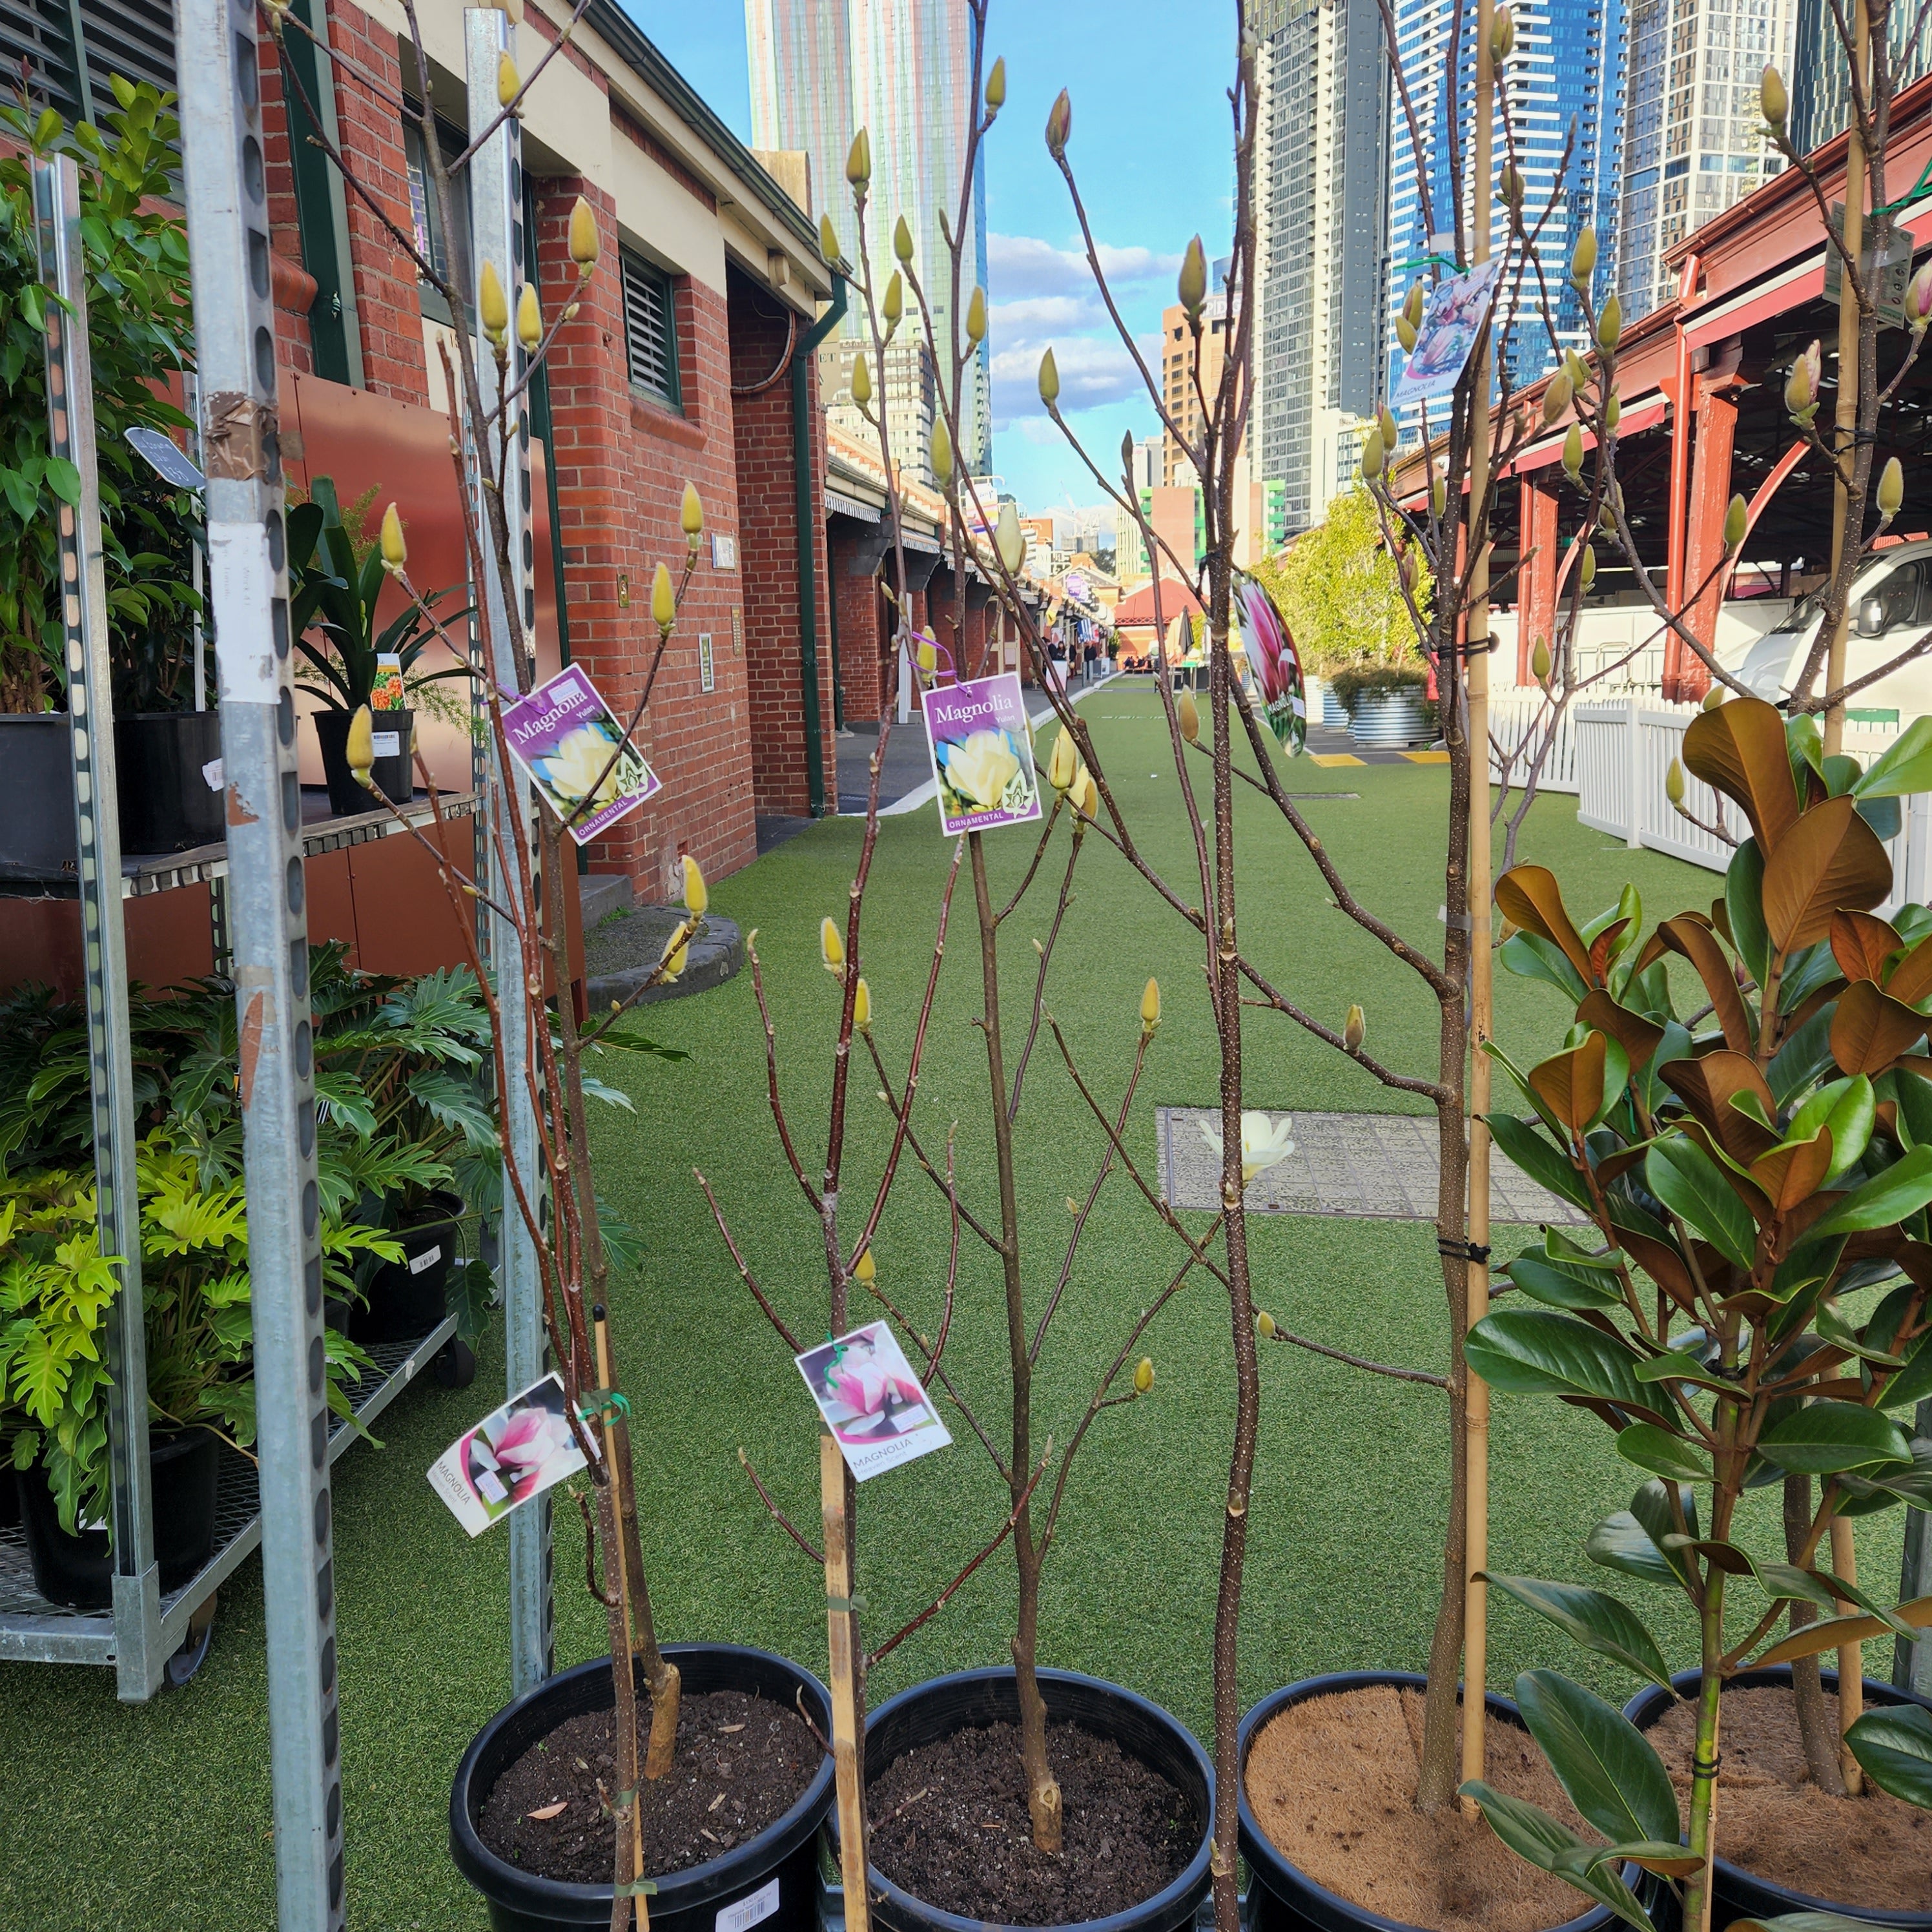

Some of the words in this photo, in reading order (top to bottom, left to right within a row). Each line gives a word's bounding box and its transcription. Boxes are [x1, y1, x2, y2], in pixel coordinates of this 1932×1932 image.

[512, 691, 588, 745] Magnolia
[576, 704, 596, 719] Yulan
[935, 694, 1013, 724] Magnolia
[995, 715, 1015, 724] Yulan
[578, 799, 628, 836] ORNAMENTAL
[949, 812, 1004, 829] ORNAMENTAL
[852, 1438, 914, 1469] MAGNOLIA
[436, 1461, 471, 1505] MAGNOLIA
